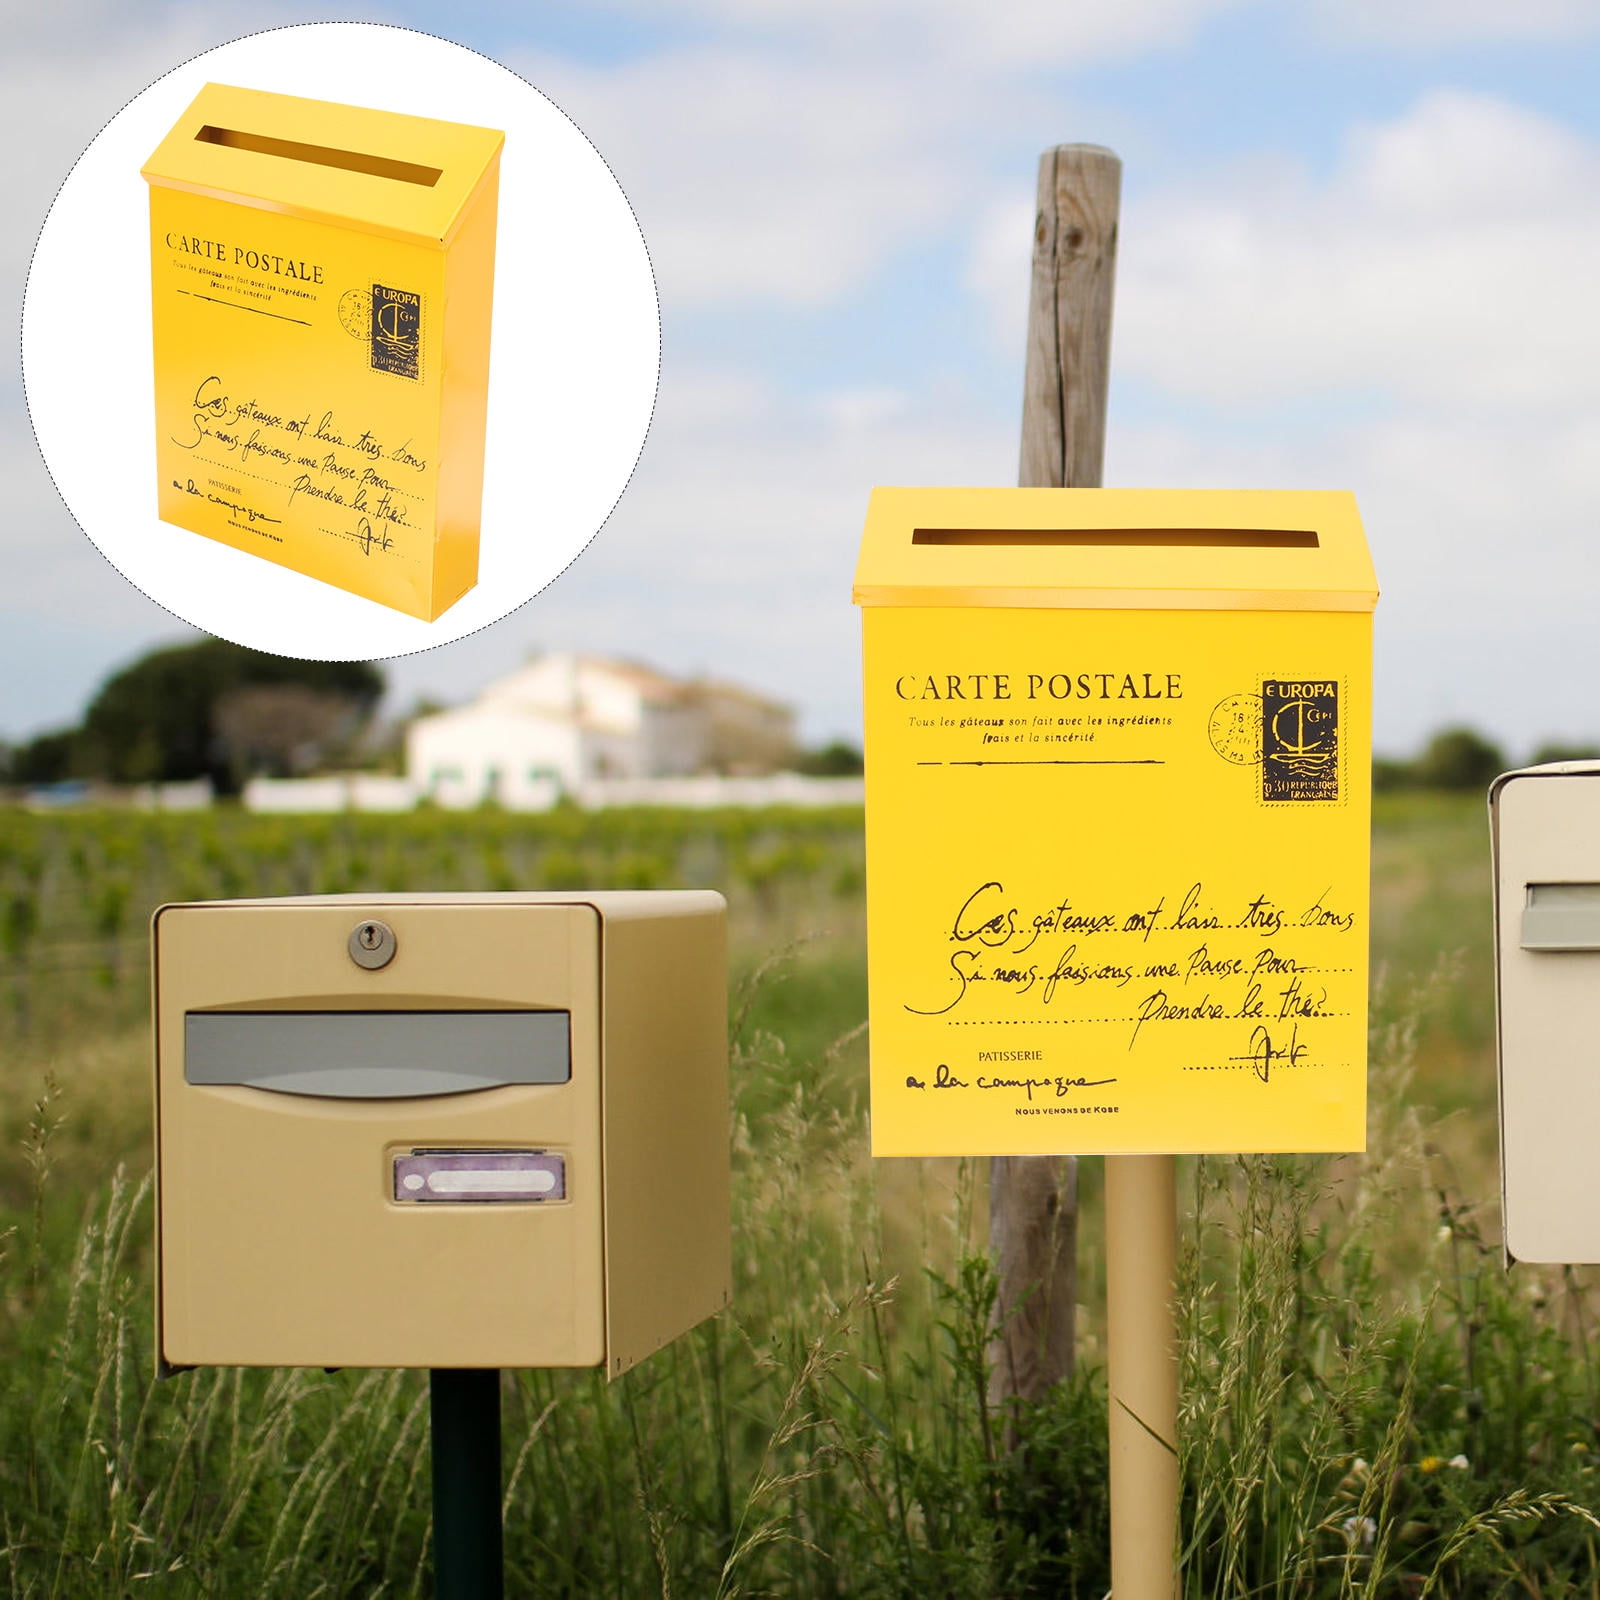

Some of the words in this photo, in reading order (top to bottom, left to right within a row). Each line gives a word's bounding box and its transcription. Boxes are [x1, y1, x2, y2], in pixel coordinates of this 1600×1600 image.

[166, 232, 226, 262] CARTE
[234, 247, 324, 285] POSTALE
[374, 287, 418, 307] EUROPA
[225, 399, 282, 427] gâteaux
[286, 414, 311, 440] ont
[354, 430, 383, 461] très
[297, 458, 318, 469] une
[207, 478, 243, 495] PATISSERIE
[350, 489, 368, 514] le
[896, 675, 1012, 700] CARTE
[1027, 673, 1184, 700] POSTALE
[1265, 683, 1335, 698] EUROPA
[909, 716, 935, 727] Tous
[940, 716, 956, 727] les
[1009, 718, 1028, 726] son
[1031, 715, 1053, 727] fait
[1057, 717, 1083, 726] avec
[1087, 715, 1103, 726] les
[1107, 715, 1173, 728] ingrédients
[1014, 733, 1025, 743] et
[1029, 732, 1040, 743] la
[1044, 732, 1095, 743] sincérité
[1012, 898, 1116, 954] gâteaux
[1122, 896, 1164, 943] ont
[1239, 894, 1285, 937] très
[904, 950, 983, 1015] Si
[993, 965, 1039, 994] nous
[1043, 944, 1133, 1004] faisions
[1144, 963, 1178, 977] une
[1235, 983, 1264, 1018] le
[978, 1050, 1043, 1062] PATISSERIE
[976, 1076, 1117, 1101] campagne
[1015, 1107, 1041, 1116] NOUS
[1043, 1107, 1079, 1115] VENONS
[1094, 1106, 1119, 1114] KOBE
